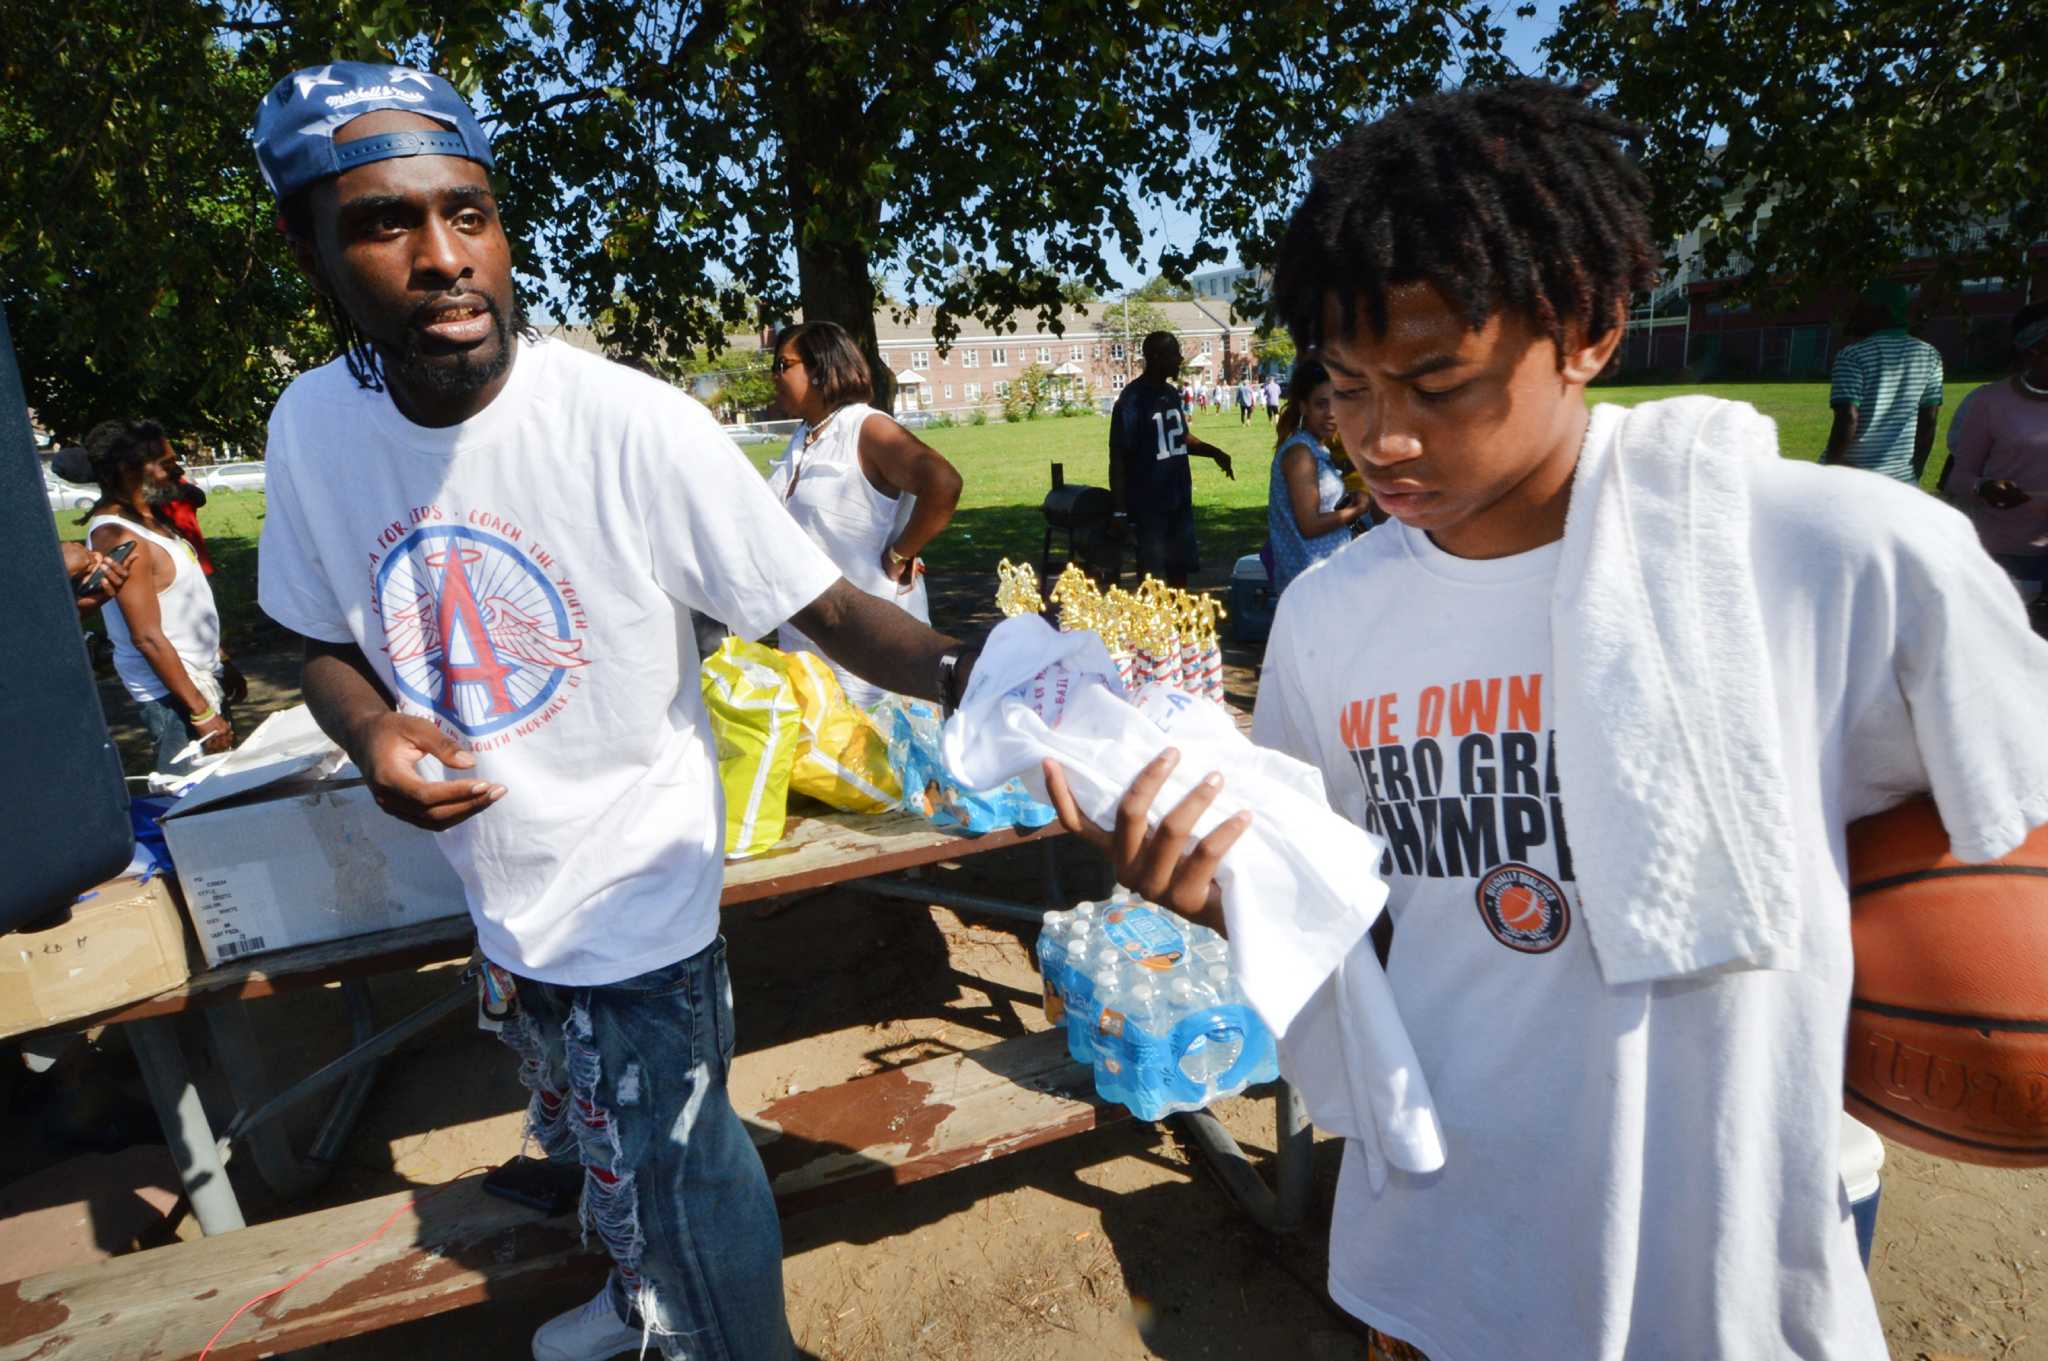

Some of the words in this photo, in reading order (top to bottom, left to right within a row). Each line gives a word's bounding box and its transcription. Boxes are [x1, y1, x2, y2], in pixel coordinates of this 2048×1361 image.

[1152, 408, 1188, 461] 12
[377, 520, 408, 550] FOR
[469, 508, 522, 542] COACH
[529, 541, 555, 569] THE
[556, 577, 588, 630] YOUTH
[1340, 692, 1399, 751] WE
[1416, 673, 1542, 737] OWN
[1350, 738, 1443, 802] ERO
